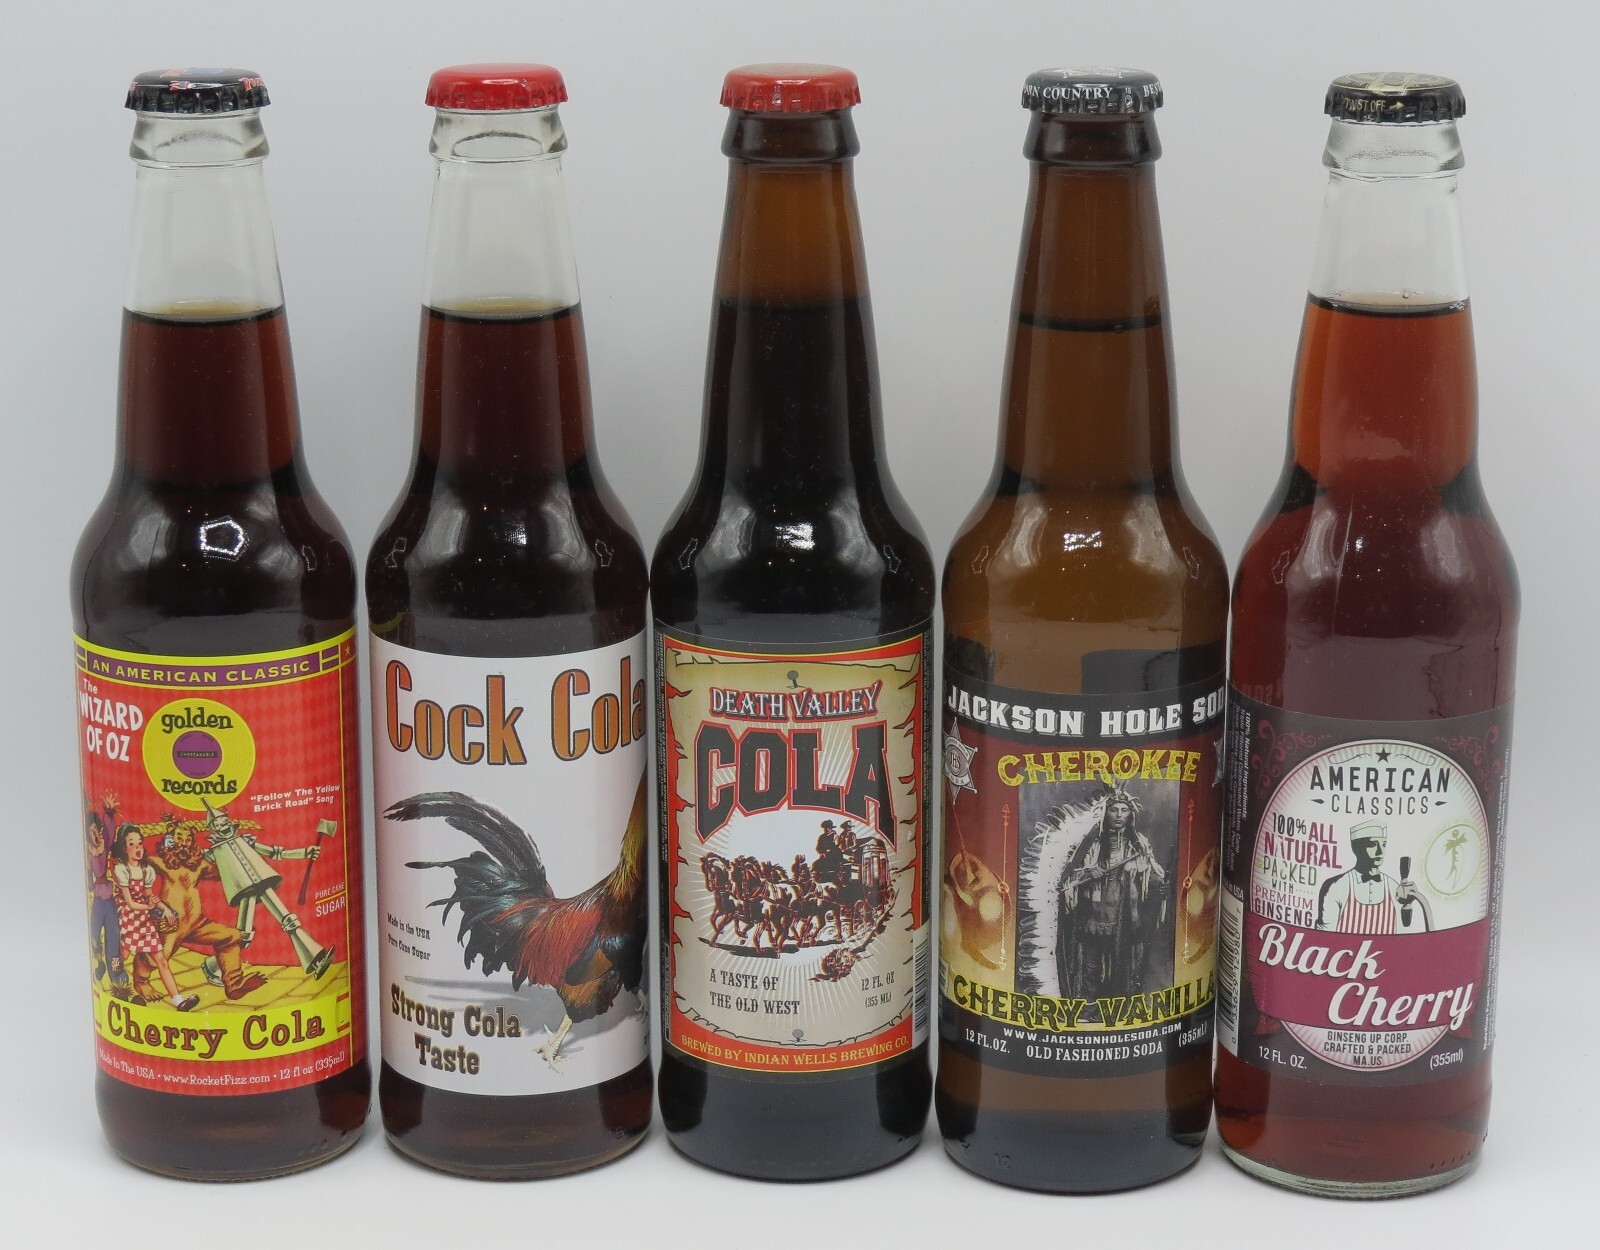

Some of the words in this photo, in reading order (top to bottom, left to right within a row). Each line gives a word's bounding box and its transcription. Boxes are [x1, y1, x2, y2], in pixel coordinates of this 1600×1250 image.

[1043, 87, 1113, 100] COUNTRY
[1345, 98, 1368, 110] TWIST
[1370, 100, 1386, 112] OFF
[92, 659, 110, 673] AN
[116, 665, 217, 683] AMERICAN
[226, 660, 310, 680] CLASSIC
[82, 679, 97, 694] The
[79, 691, 143, 731] WIZARD
[386, 659, 527, 765] Cock
[551, 655, 645, 761] Cola
[710, 687, 789, 722] DEATH
[790, 680, 883, 723] VALLEY
[948, 685, 1085, 737] JACKSON
[1100, 703, 1182, 738] HOLE
[1192, 686, 1224, 724] SOD
[162, 707, 233, 733] golden
[86, 725, 103, 753] OF
[106, 732, 130, 762] OZ
[997, 748, 1201, 787] CHEROKEE
[1309, 766, 1450, 793] AMERICAN
[162, 775, 237, 795] records
[295, 787, 312, 797] The
[315, 784, 340, 793] Yellow
[694, 720, 897, 851] COLA
[254, 802, 281, 813] Brick
[316, 794, 334, 804] Song
[1331, 795, 1429, 816] CLASSICS
[1273, 813, 1307, 837] 100%
[1309, 822, 1337, 844] ALL
[1265, 832, 1342, 869] NATURAL
[1263, 855, 1317, 886] PACKED
[315, 888, 330, 899] PURE
[332, 882, 344, 893] CANE
[1256, 885, 1313, 910] PREMIUM
[1272, 878, 1294, 894] WITH
[316, 897, 345, 917] SUGAR
[1255, 898, 1313, 927] GINSENG
[387, 912, 398, 927] Made
[400, 920, 404, 931] in
[406, 923, 414, 934] the
[416, 927, 430, 940] USA
[388, 933, 397, 947] Pure
[399, 940, 410, 954] Cane
[412, 946, 430, 960] Sugar
[1258, 923, 1386, 980] Black
[710, 968, 716, 982] A
[720, 970, 758, 990] TASTE
[762, 977, 779, 991] OF
[861, 978, 869, 990] 12
[872, 975, 883, 988] FL.
[886, 971, 894, 984] OZ
[391, 982, 454, 1038] Strong
[464, 1004, 522, 1038] Cola
[710, 991, 731, 1009] THE
[736, 998, 759, 1012] OLD
[764, 1000, 800, 1015] WEST
[865, 996, 878, 1008] (355
[880, 992, 891, 1004] ML)
[953, 974, 1086, 1032] CHERRY
[1097, 968, 1215, 1028] VANILLA
[1328, 982, 1474, 1031] Cherry
[108, 1001, 227, 1059] Cherry
[243, 1010, 325, 1049] Cola
[966, 1028, 975, 1042] 12
[1003, 1022, 1182, 1045] WWW.JACKSONHOLESODA.COM
[1327, 1031, 1367, 1043] GINSENG
[1370, 1033, 1382, 1043] UP
[1385, 1032, 1409, 1043] CORP.
[414, 1032, 480, 1075] Taste
[681, 1034, 722, 1057] BREWED
[725, 1049, 741, 1061] BY
[744, 1052, 789, 1065] INDIAN
[793, 1053, 837, 1065] WELLS
[841, 1040, 893, 1062] BREWING
[895, 1036, 909, 1047] CO.
[1026, 1045, 1052, 1060] OLD
[1055, 1045, 1130, 1062] FASHIONED
[1133, 1041, 1163, 1057] SODA
[1259, 1045, 1270, 1059] 12
[1272, 1050, 1287, 1065] FL.
[1290, 1055, 1308, 1069] OZ.
[1324, 1041, 1366, 1054] CRAFTED
[1369, 1045, 1374, 1053] &
[1377, 1043, 1411, 1054] PACKED
[1429, 1049, 1463, 1070] (355ml)
[100, 1048, 112, 1065] Made
[114, 1057, 120, 1069] In
[121, 1061, 134, 1074] The
[137, 1066, 155, 1079] USA
[163, 1073, 270, 1086] www.RocketFizz.com
[280, 1069, 290, 1079] 12
[294, 1067, 300, 1077] fl
[303, 1066, 313, 1075] oz
[1353, 1055, 1383, 1066] MA.US
